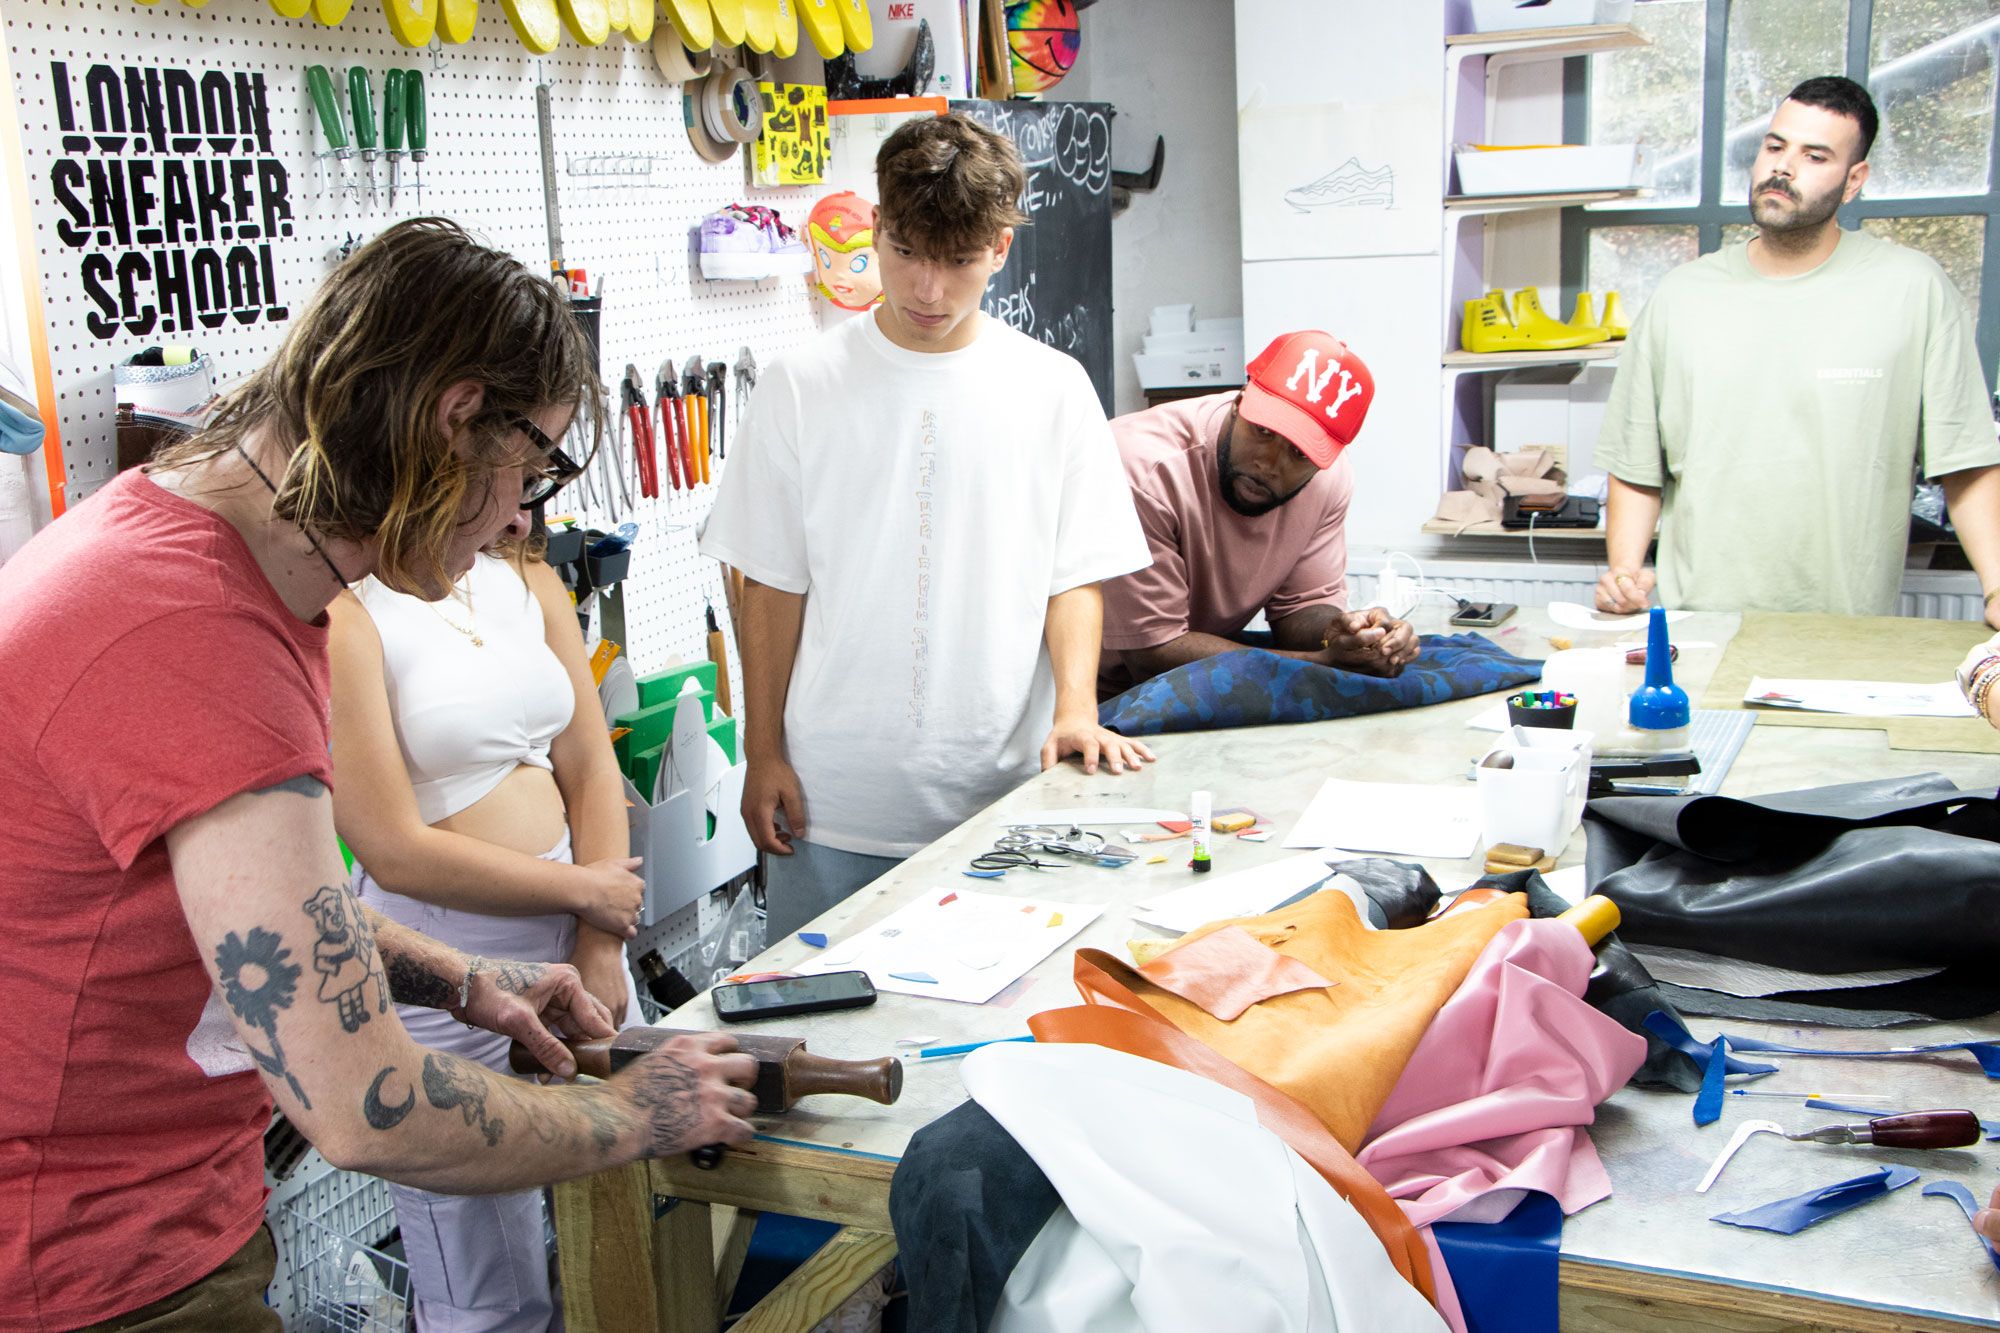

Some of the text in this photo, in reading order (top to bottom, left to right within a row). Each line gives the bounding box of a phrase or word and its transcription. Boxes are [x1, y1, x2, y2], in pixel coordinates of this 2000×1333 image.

[888, 3, 914, 17] NIKE
[51, 62, 274, 155] LONDON
[51, 160, 293, 248] SNEAKER
[82, 245, 289, 340] SCHOOL
[1285, 348, 1362, 419] NY
[1816, 368, 1883, 378] ESSENTIALS
